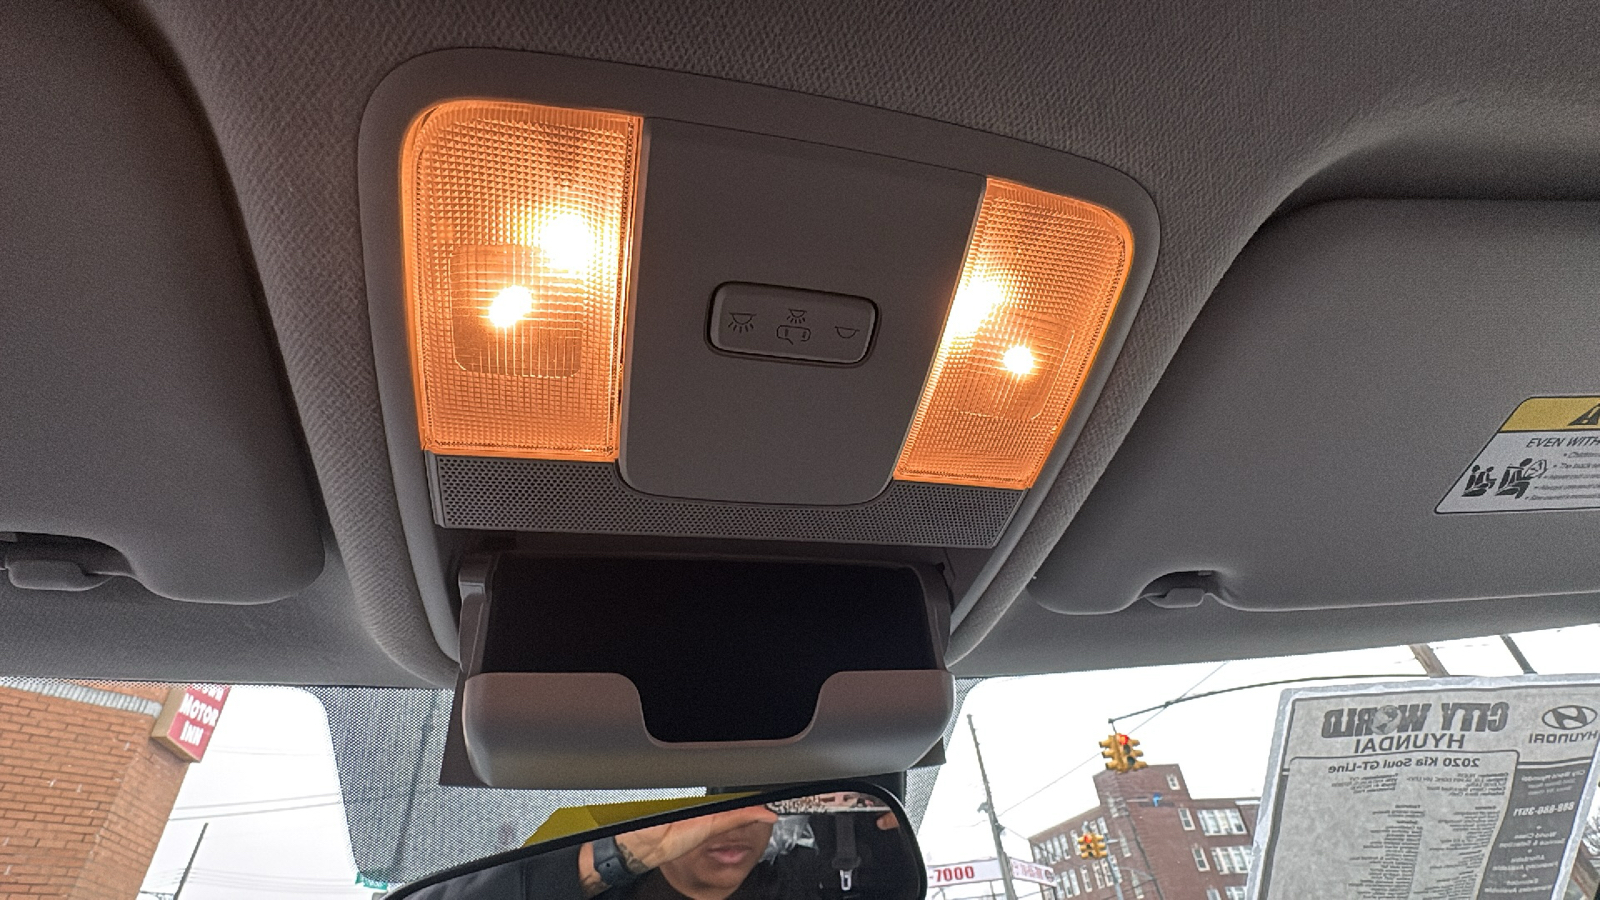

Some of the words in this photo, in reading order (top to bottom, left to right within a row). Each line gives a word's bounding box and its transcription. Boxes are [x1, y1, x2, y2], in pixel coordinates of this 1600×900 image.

[1526, 437, 1565, 448] EVEN
[179, 693, 219, 727] MOTOR
[179, 720, 204, 746] INN
